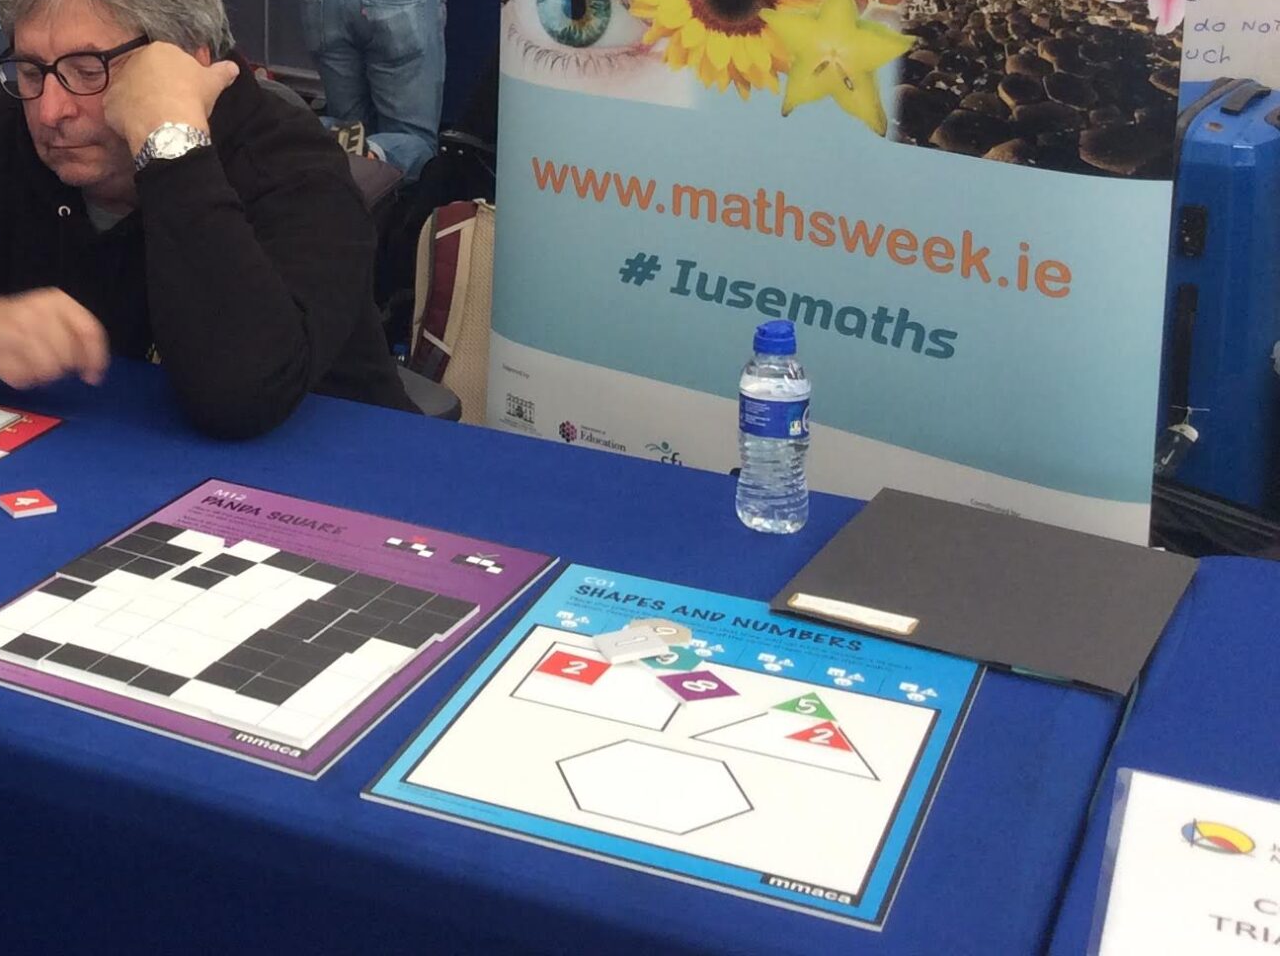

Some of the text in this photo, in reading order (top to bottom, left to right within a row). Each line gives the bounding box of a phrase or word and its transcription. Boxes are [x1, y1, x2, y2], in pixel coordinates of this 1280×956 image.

[1185, 45, 1231, 64] uch
[532, 156, 1072, 298] www.mathsweek.ie
[580, 430, 626, 452] Education
[201, 495, 262, 517] PANDA
[266, 511, 348, 536] SQUARE
[575, 585, 666, 611] SHAPES
[672, 605, 726, 622] AND
[731, 616, 862, 651] NUMBERS
[561, 660, 589, 676] 2
[795, 698, 820, 714] 5
[235, 733, 301, 758] mmaca
[807, 728, 834, 744] 2
[769, 877, 851, 904] mmaca
[1208, 913, 1280, 945] TRI
